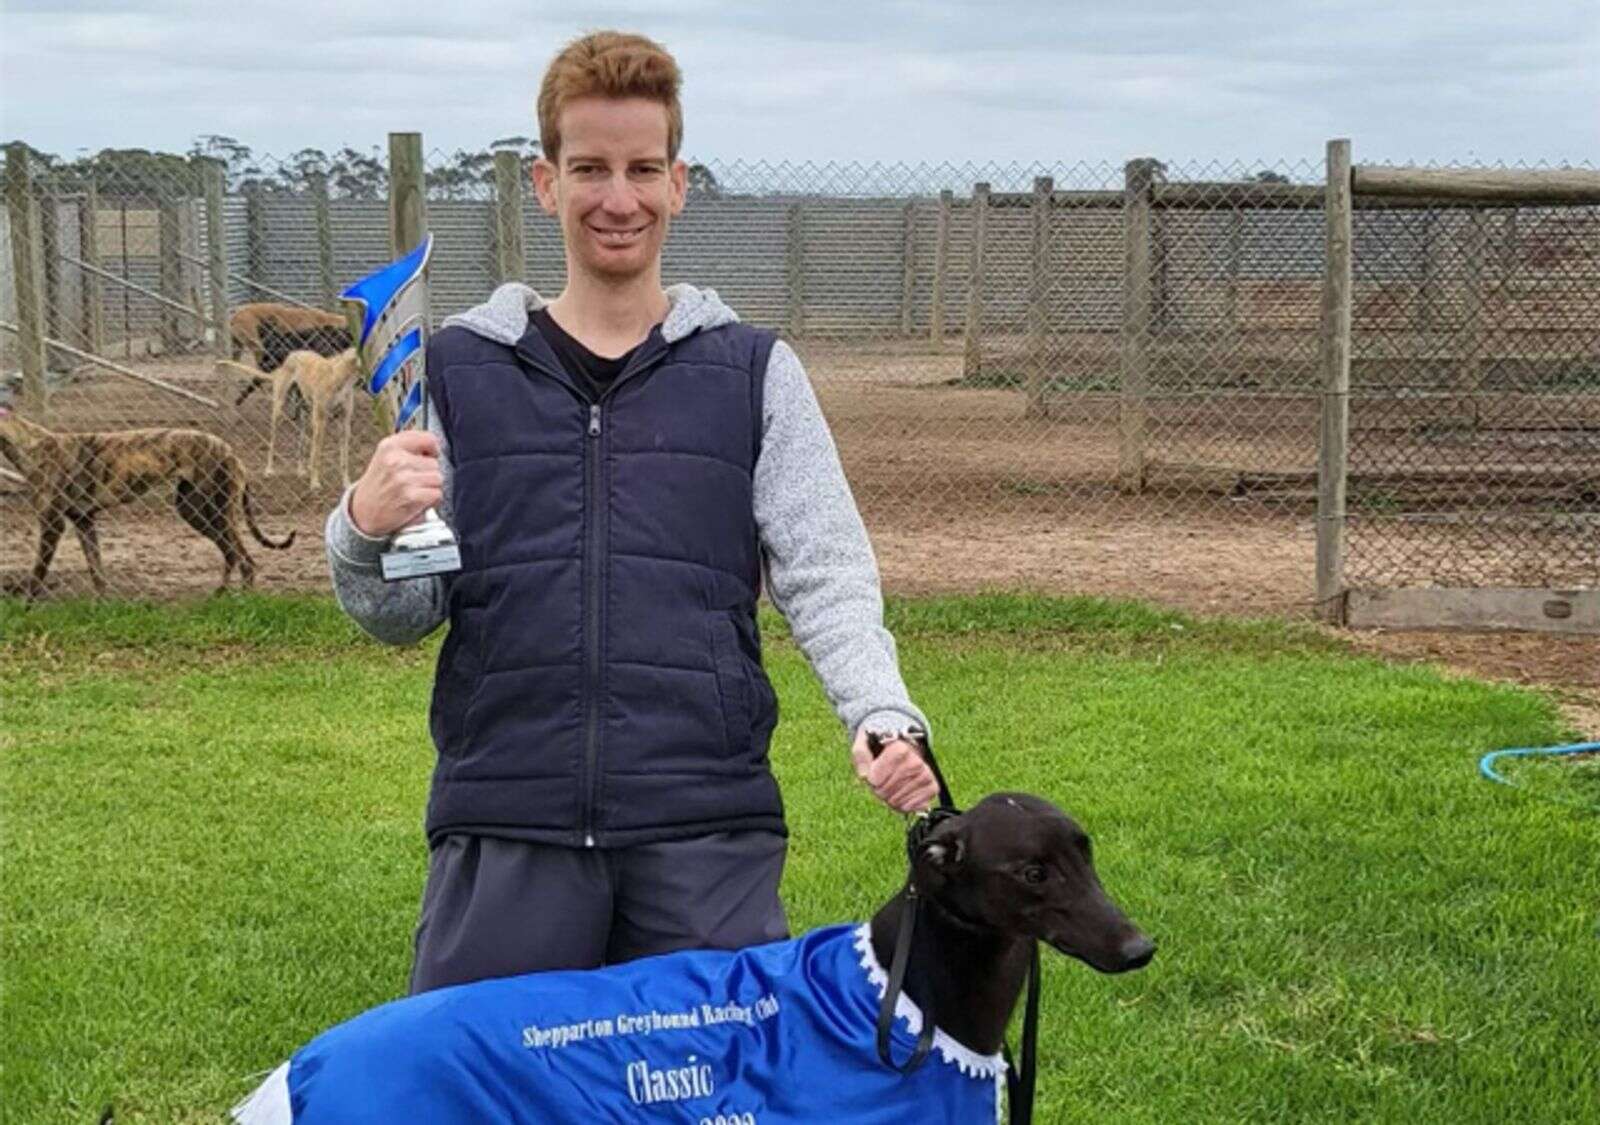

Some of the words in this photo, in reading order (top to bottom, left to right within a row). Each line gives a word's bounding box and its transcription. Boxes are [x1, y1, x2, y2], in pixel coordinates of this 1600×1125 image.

[523, 1020, 613, 1047] Shepparton
[617, 1010, 699, 1034] Greyhound
[702, 1001, 754, 1026] Racing
[627, 1055, 714, 1104] Classic
